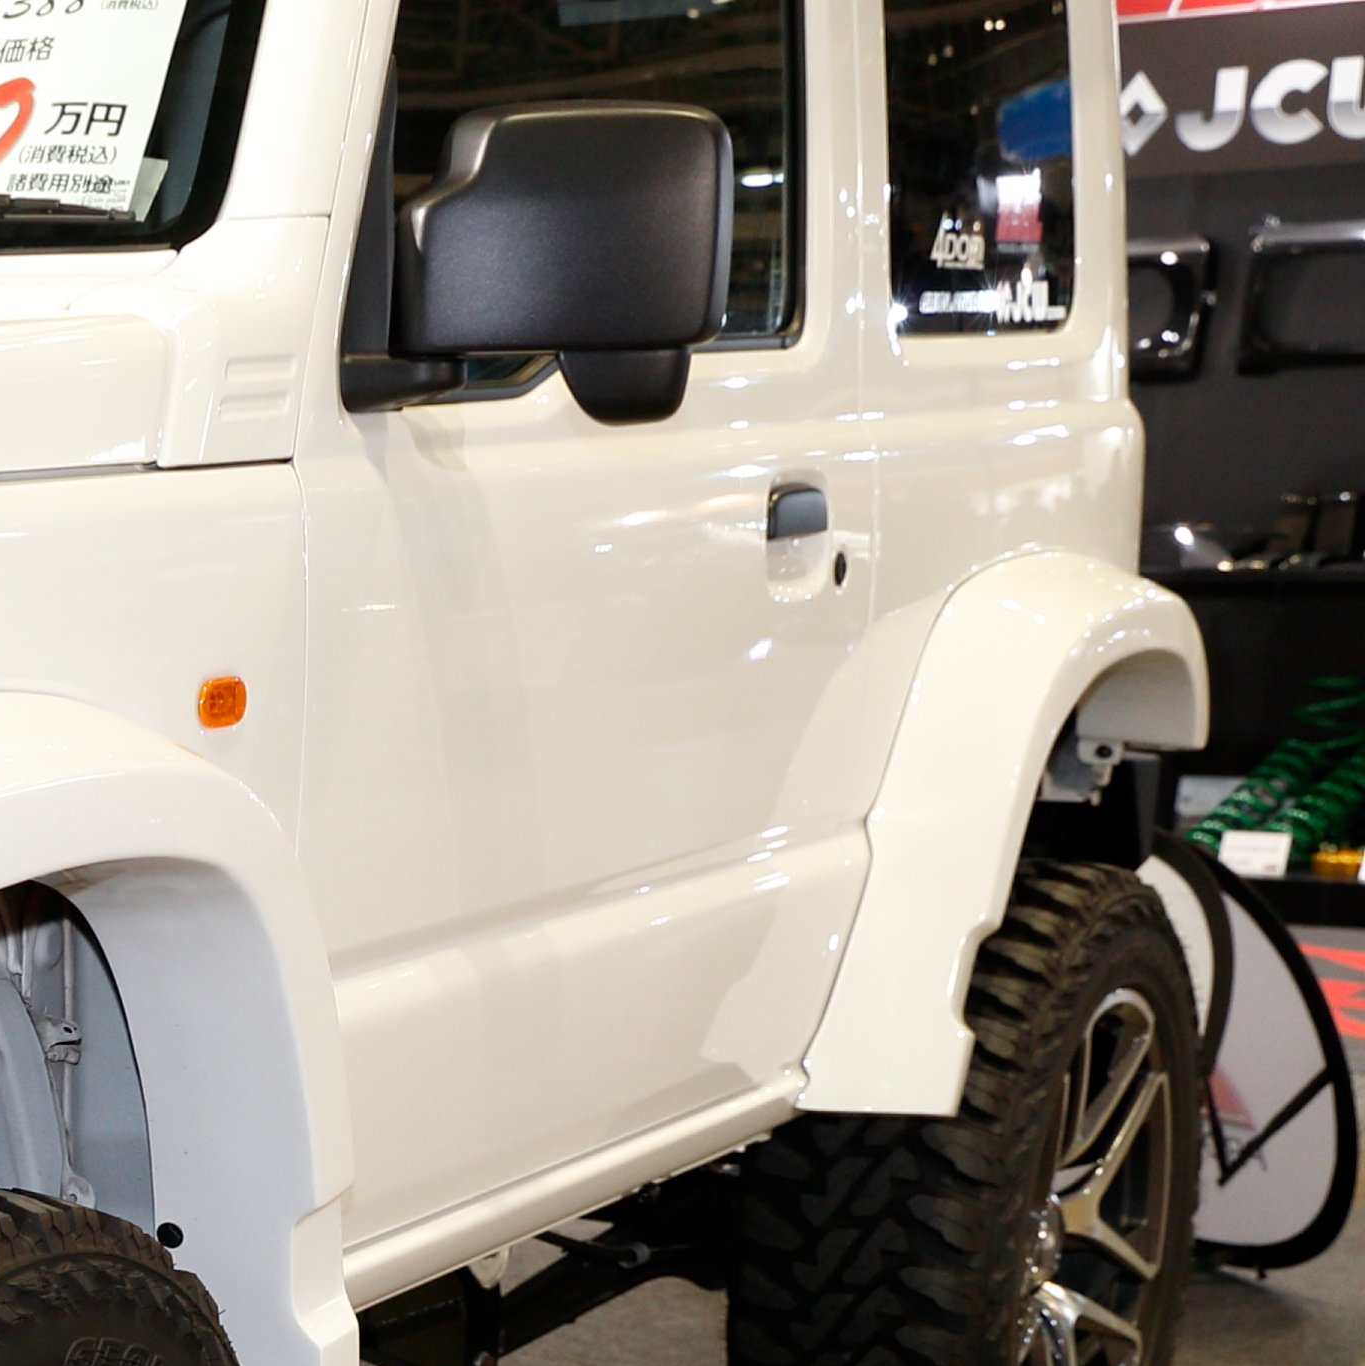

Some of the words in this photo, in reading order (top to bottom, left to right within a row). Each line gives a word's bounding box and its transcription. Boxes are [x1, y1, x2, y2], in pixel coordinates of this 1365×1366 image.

[44, 102, 128, 137] 万円
[18, 145, 117, 166] (消費税込)
